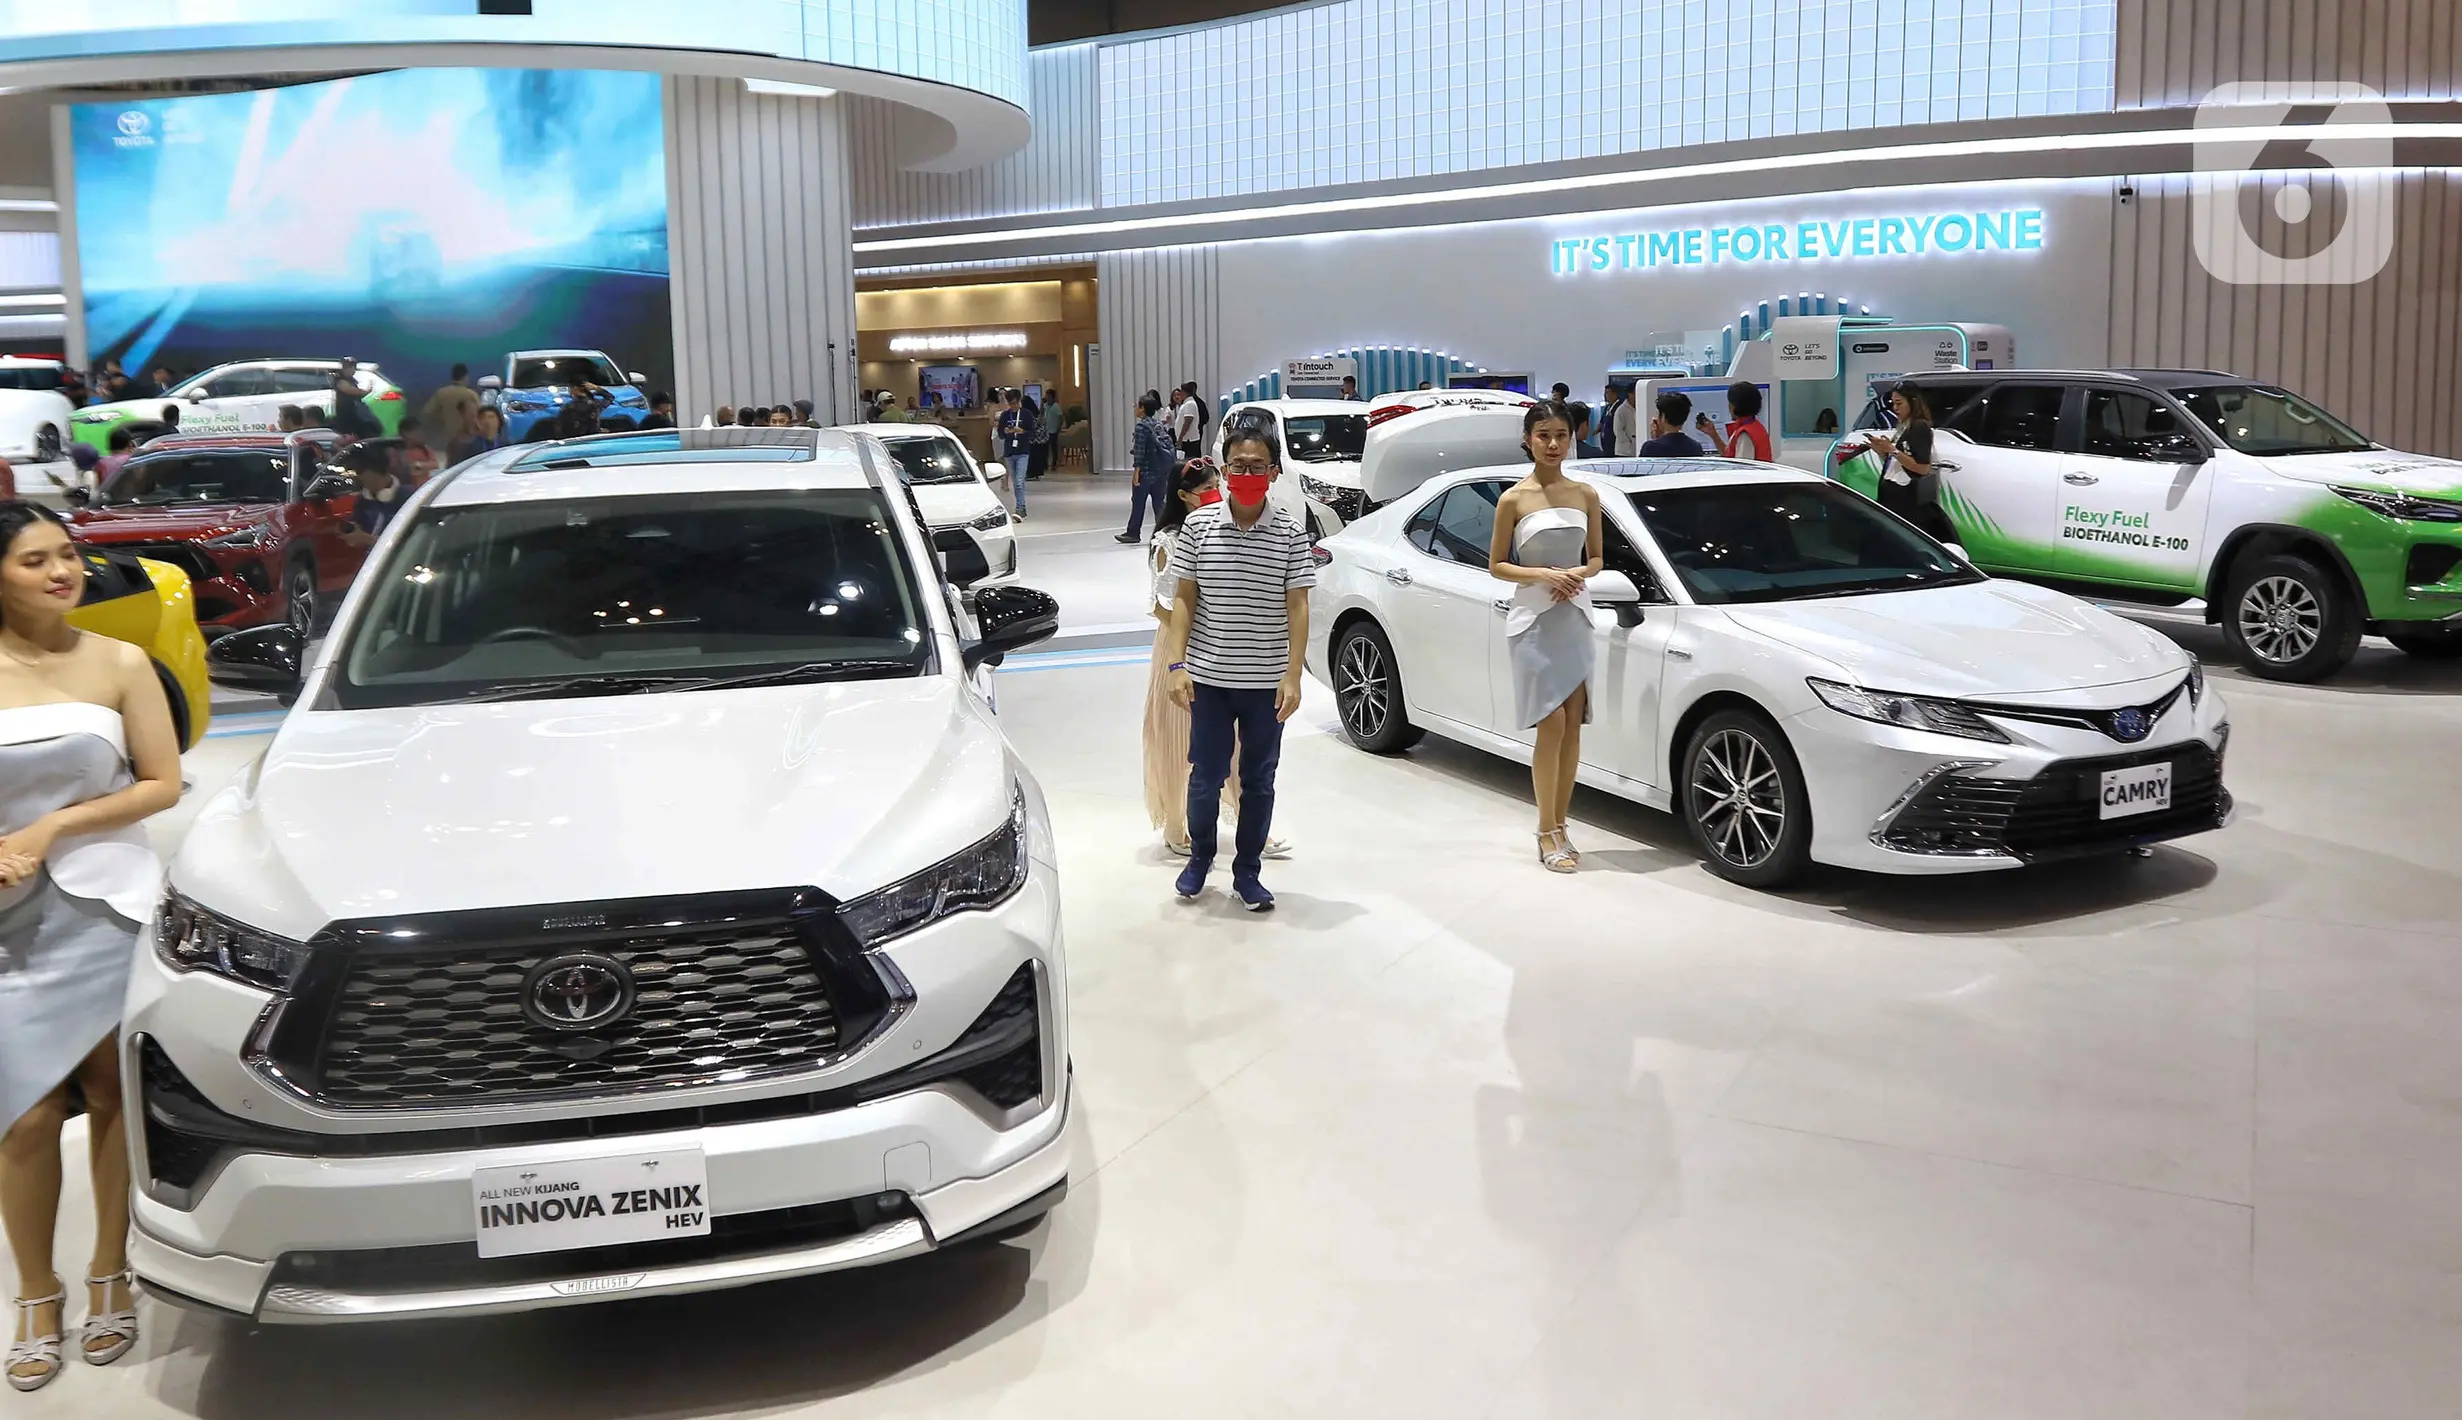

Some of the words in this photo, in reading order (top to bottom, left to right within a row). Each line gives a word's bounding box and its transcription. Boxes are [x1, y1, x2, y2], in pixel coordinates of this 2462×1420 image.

[1552, 237, 1610, 273] IT'S
[1615, 230, 1702, 268] TIME
[1711, 225, 1789, 264] FOR
[1797, 209, 2041, 259] EVERYONE
[180, 415, 212, 425] Flexy
[215, 412, 240, 423] Fuel
[2065, 506, 2109, 528] Flexy
[2111, 510, 2149, 529] Fuel
[2063, 526, 2150, 547] BIOETHANOL
[2151, 535, 2189, 551] E-100
[2103, 778, 2169, 806] CAMRY
[480, 1190, 502, 1200] ALL
[503, 1186, 532, 1198] NEW
[534, 1181, 580, 1195] KIJANG
[480, 1195, 606, 1229] INNOVA
[611, 1184, 703, 1215] ZENIX
[665, 1211, 704, 1229] HEV
[567, 1277, 628, 1293] MODELLISTA
